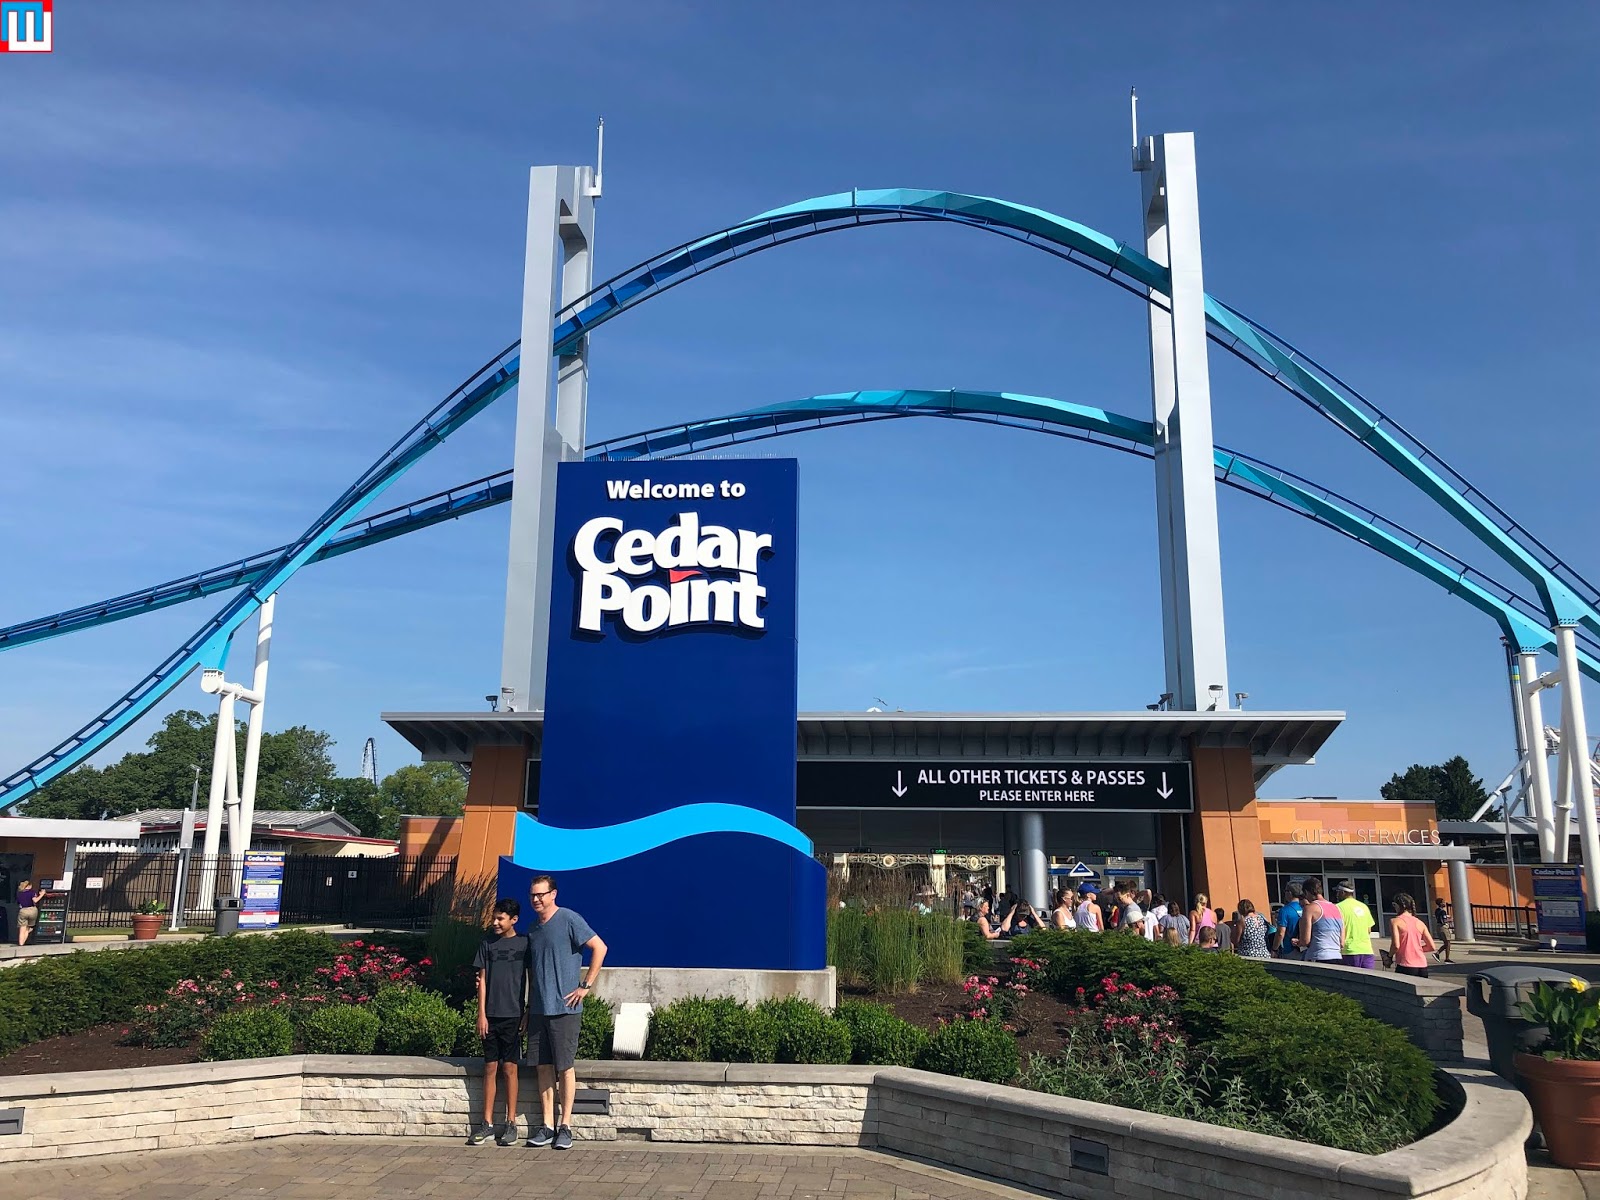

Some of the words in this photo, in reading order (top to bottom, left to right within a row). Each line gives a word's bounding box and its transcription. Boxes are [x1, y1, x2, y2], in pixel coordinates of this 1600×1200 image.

[607, 479, 715, 499] Welcome
[720, 480, 746, 498] to
[574, 511, 773, 576] Cedar
[578, 569, 768, 633] Point
[917, 769, 946, 785] ALL
[949, 769, 1001, 785] OTHER
[1004, 769, 1067, 785] TICKETS
[1070, 770, 1083, 785] &
[1087, 770, 1146, 786] PASSES
[979, 790, 1022, 801] PLEASE
[1025, 790, 1062, 802] ENTER
[1064, 790, 1095, 802] HERE
[1291, 828, 1348, 844] GUEST
[1356, 829, 1441, 845] SERVICES
[1534, 868, 1555, 876] Cedar
[1555, 868, 1575, 876] Point
